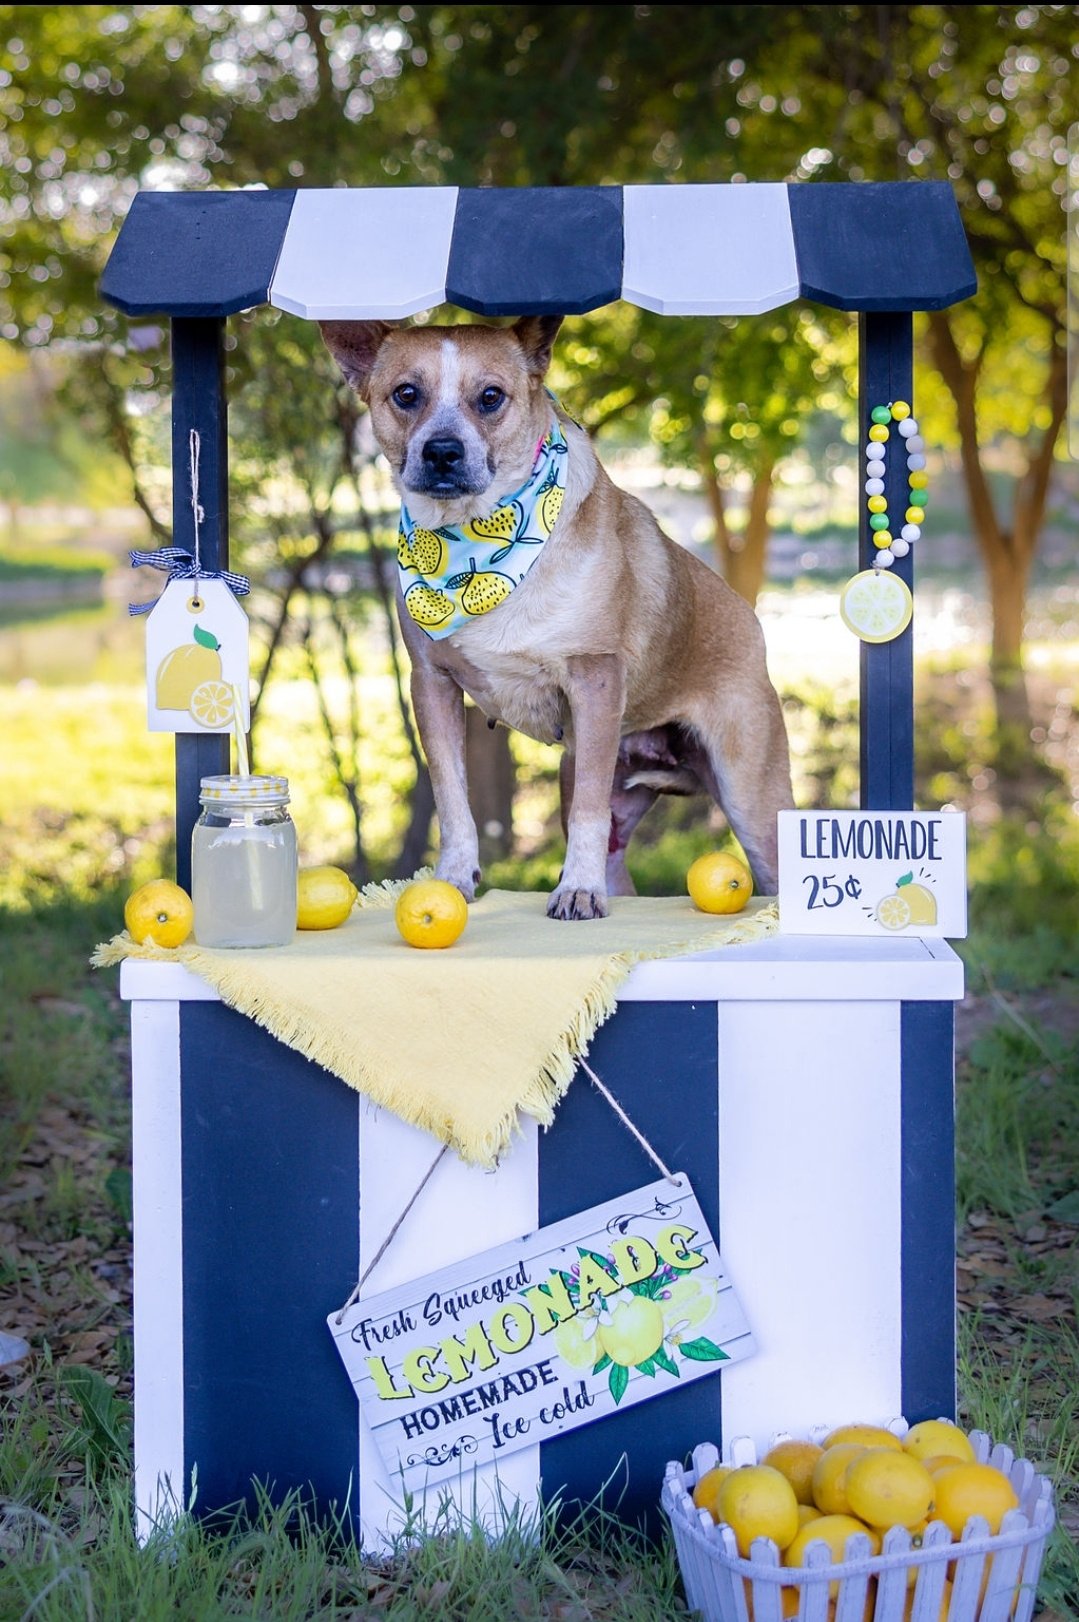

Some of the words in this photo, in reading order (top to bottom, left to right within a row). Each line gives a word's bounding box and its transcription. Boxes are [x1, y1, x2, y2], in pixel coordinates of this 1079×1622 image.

[800, 818, 942, 860] LEMONADE
[802, 874, 862, 910] 25¢
[351, 1311, 417, 1351] Fresh
[364, 1224, 708, 1401] LEMONADE
[400, 1360, 559, 1440] HOMEMADE
[483, 1411, 531, 1449] Ice
[539, 1380, 595, 1426] cold
